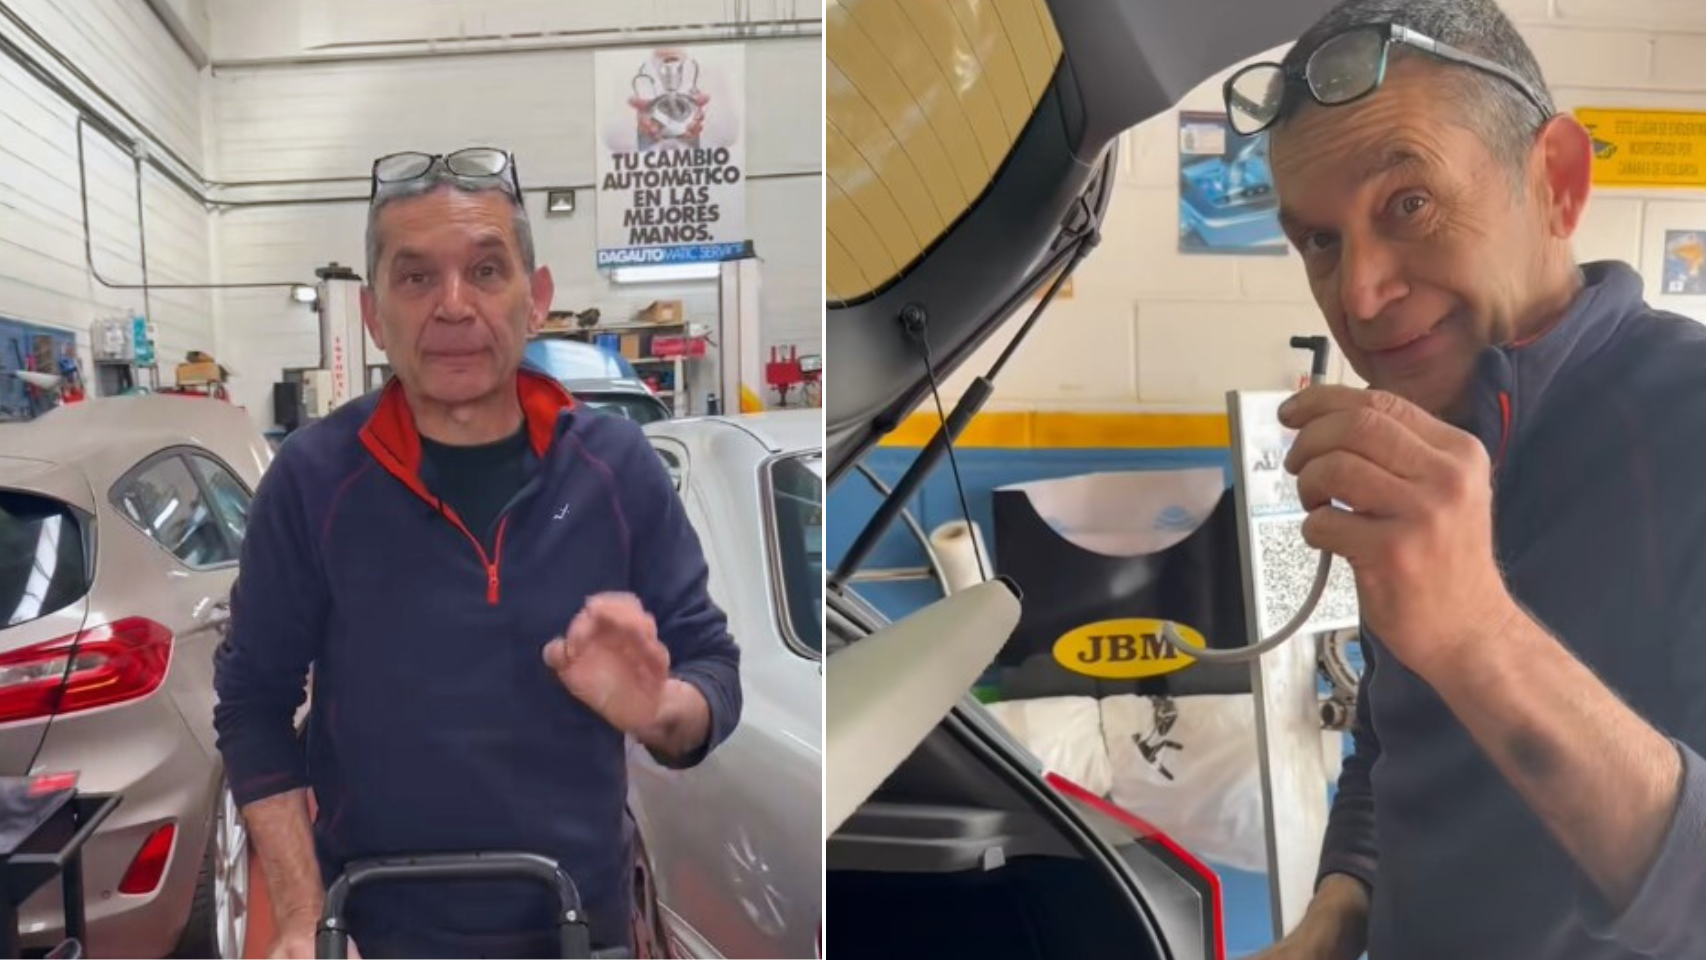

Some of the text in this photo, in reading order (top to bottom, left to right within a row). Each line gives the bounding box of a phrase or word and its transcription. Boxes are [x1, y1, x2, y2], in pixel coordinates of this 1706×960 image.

[612, 147, 730, 171] TU CAMBIO
[634, 186, 710, 207] EN LAS
[623, 204, 719, 227] MEJORES
[629, 225, 714, 245] MANOS.
[1077, 633, 1178, 663] JBM
